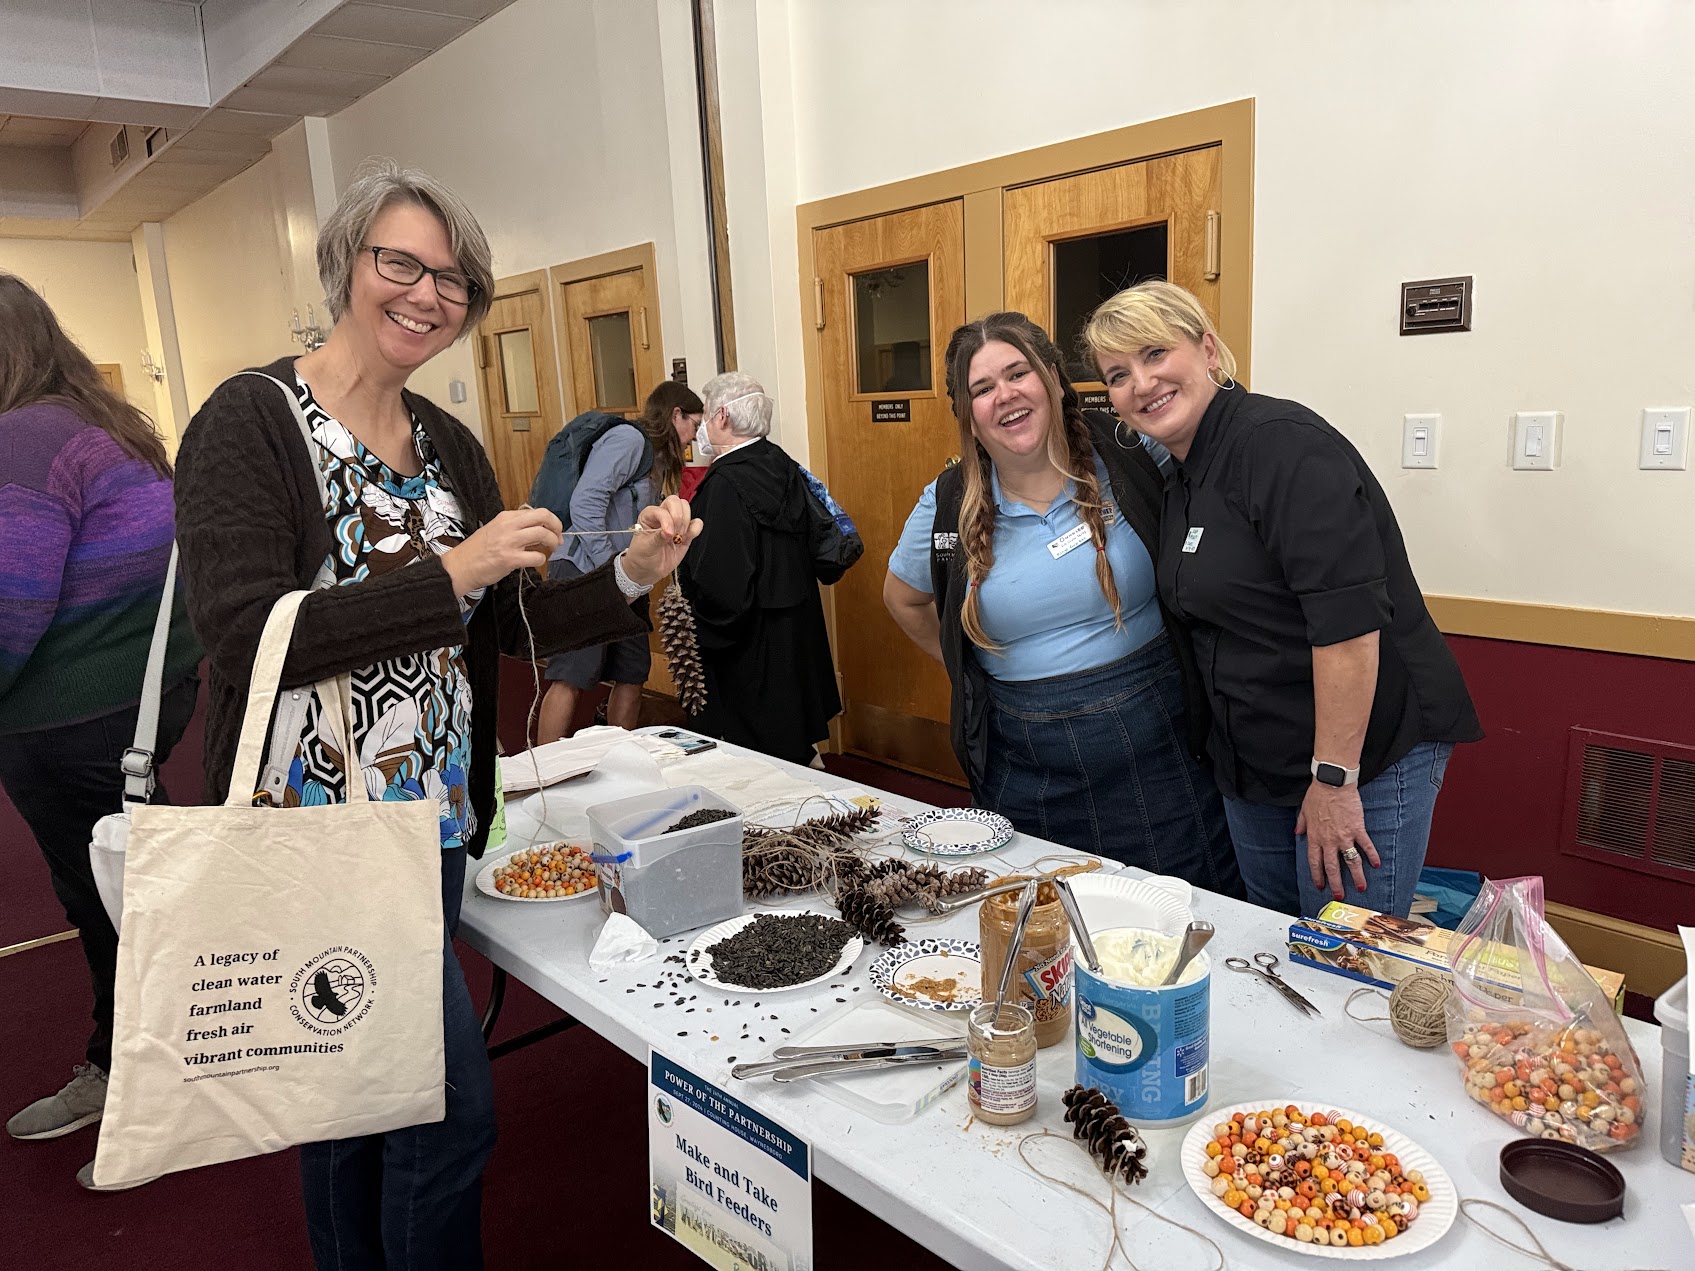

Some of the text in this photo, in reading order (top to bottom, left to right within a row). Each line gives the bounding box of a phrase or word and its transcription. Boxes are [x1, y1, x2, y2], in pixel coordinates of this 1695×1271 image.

[1291, 932, 1329, 947] surefresh
[194, 949, 280, 967] A legacy of
[289, 946, 377, 993] SOUTH MOUNTAIN PARTNERSHIP
[191, 974, 283, 992] clean water
[188, 998, 262, 1017] farmland
[289, 999, 375, 1036] CONSERVATION NETWORK
[186, 1023, 254, 1042] fresh air
[1088, 1021, 1132, 1045] Vegetable
[184, 1042, 344, 1066] vibrant communities
[1088, 1032, 1132, 1059] Shortening
[1141, 1003, 1161, 1104] BING
[183, 1064, 280, 1082] southmountainpartnership.org
[664, 1069, 793, 1155] POWER OF THE PARTNERSHIP
[706, 1109, 730, 1128] COUNTING
[675, 1133, 710, 1169] Make
[714, 1162, 740, 1188] and
[742, 1176, 778, 1213] Take
[685, 1166, 714, 1198] Bird
[717, 1187, 772, 1237] Feeders
